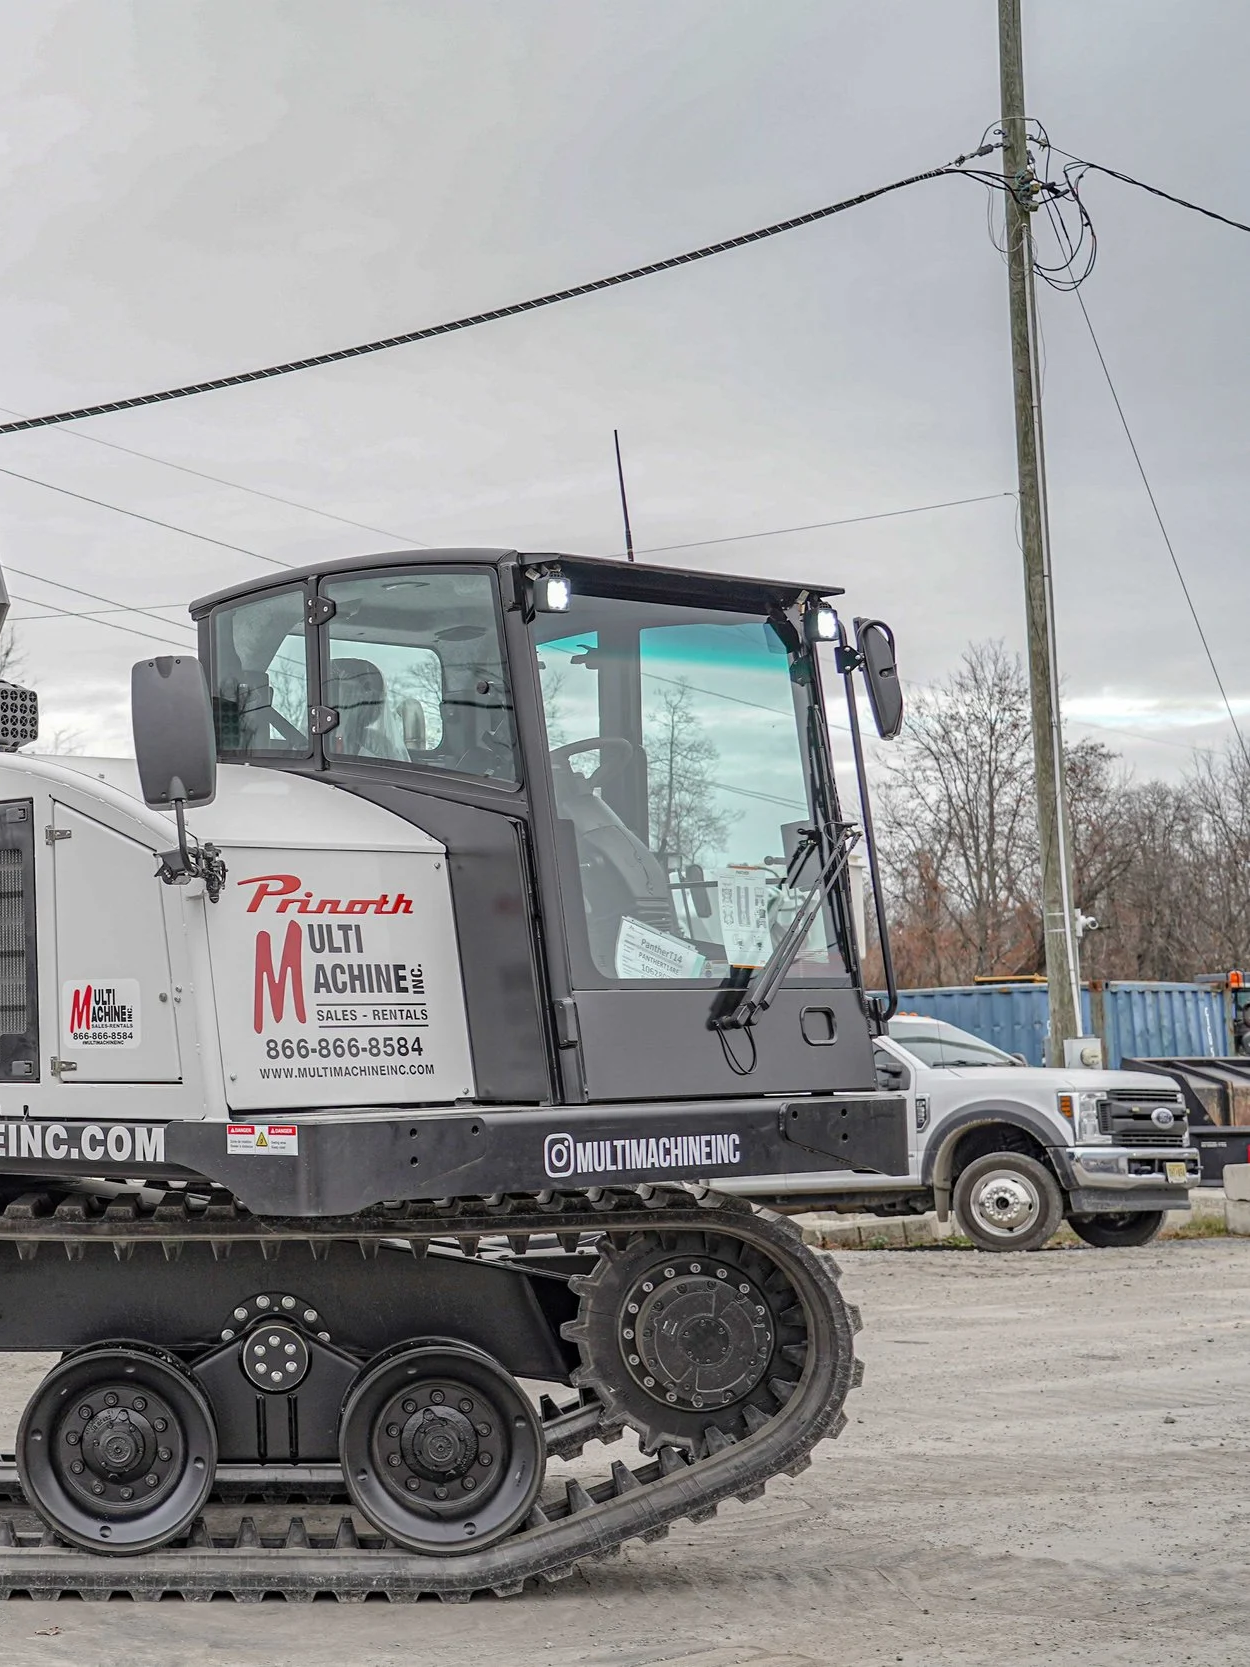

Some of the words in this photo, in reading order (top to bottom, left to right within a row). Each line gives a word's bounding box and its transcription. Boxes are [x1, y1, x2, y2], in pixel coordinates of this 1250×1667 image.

[237, 874, 414, 915] Prinoth
[410, 963, 425, 995] INC.
[316, 1009, 358, 1022] SALES
[372, 1008, 429, 1021] RENTALS
[72, 1032, 134, 1040] 866-866-8584
[265, 1036, 424, 1060] 866-866-8584
[259, 1063, 435, 1080] WWW.MULTIMACHINEINC.COM
[576, 1133, 741, 1174] MULTIMACHINEINC
